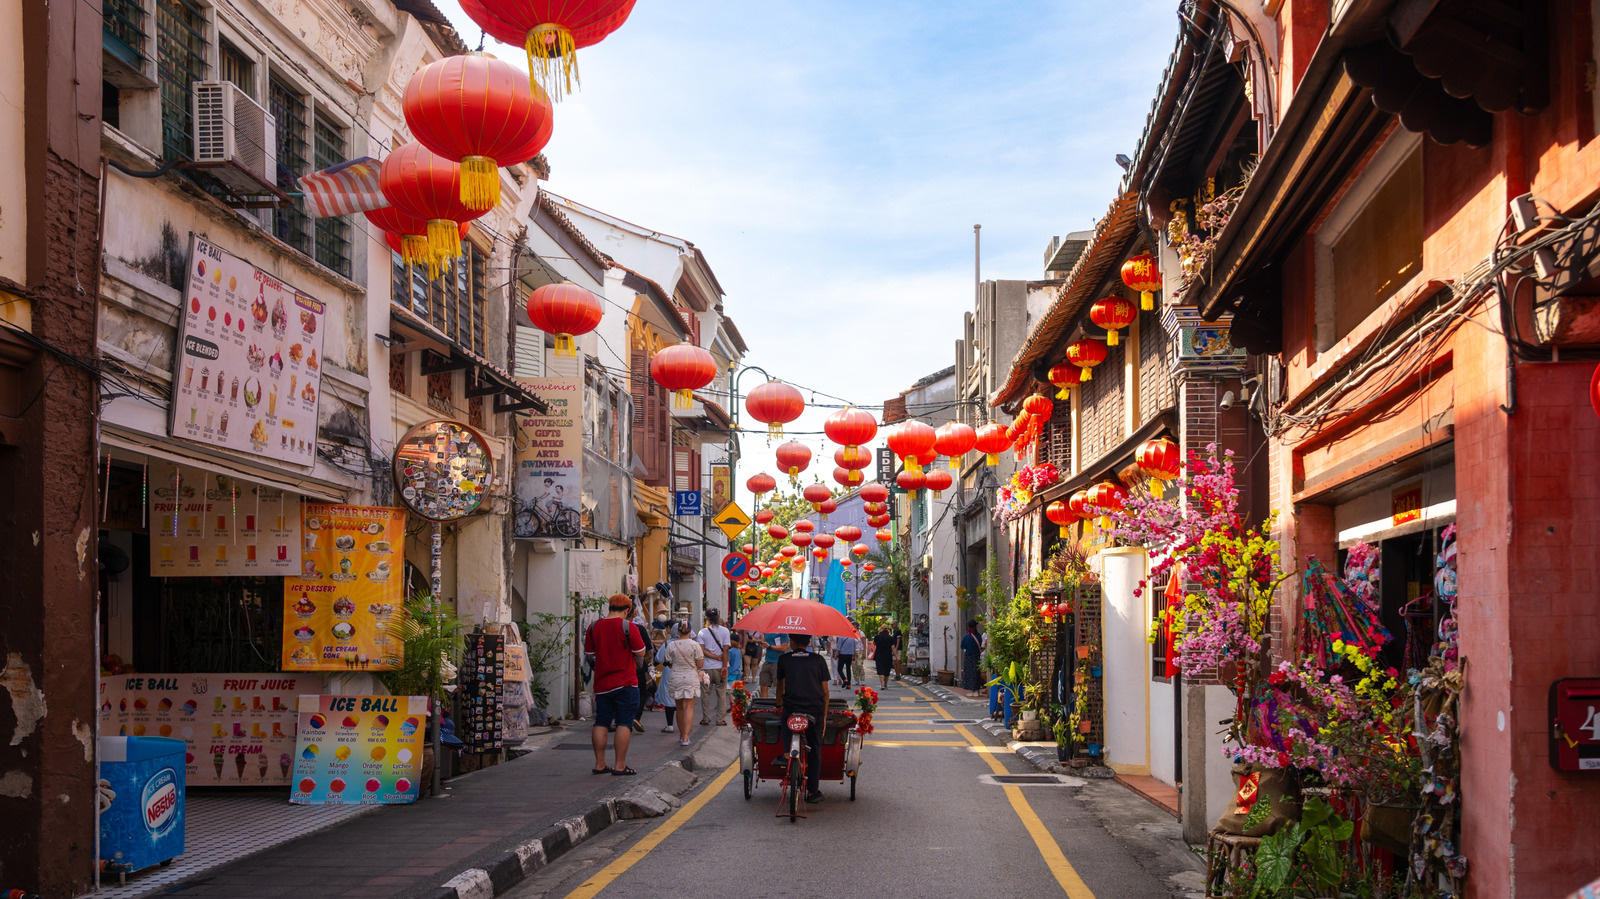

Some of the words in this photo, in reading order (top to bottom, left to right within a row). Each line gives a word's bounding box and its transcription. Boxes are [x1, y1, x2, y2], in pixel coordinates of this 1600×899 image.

[197, 241, 207, 255] ICE
[208, 246, 222, 262] BALL
[1133, 259, 1152, 277] 謝
[253, 269, 262, 282] ICE
[263, 273, 283, 292] DESSERT
[295, 295, 312, 308] WESTERN
[312, 301, 322, 313] FOOD
[185, 340, 196, 351] ICE
[195, 342, 219, 358] BLENDED
[522, 419, 573, 427] SOUVENIRS
[521, 460, 574, 468] SWIMWEAR
[680, 492, 697, 505] 19
[154, 503, 182, 512] FRUIT
[306, 505, 328, 516] ALL
[329, 506, 360, 520] STAR
[361, 508, 389, 520] CAFE
[322, 519, 370, 532] COCONUT
[305, 585, 337, 593] DESSERT
[125, 678, 144, 691] ICE
[147, 678, 179, 691] BALL
[223, 679, 259, 691] FRUIT
[260, 679, 296, 691] JUICE
[329, 697, 357, 712] ICE
[360, 697, 398, 713] BALL
[209, 745, 226, 754] ICE
[228, 745, 263, 754] CREAM
[155, 773, 171, 788] CREAM
[383, 793, 415, 801] Strawberry
